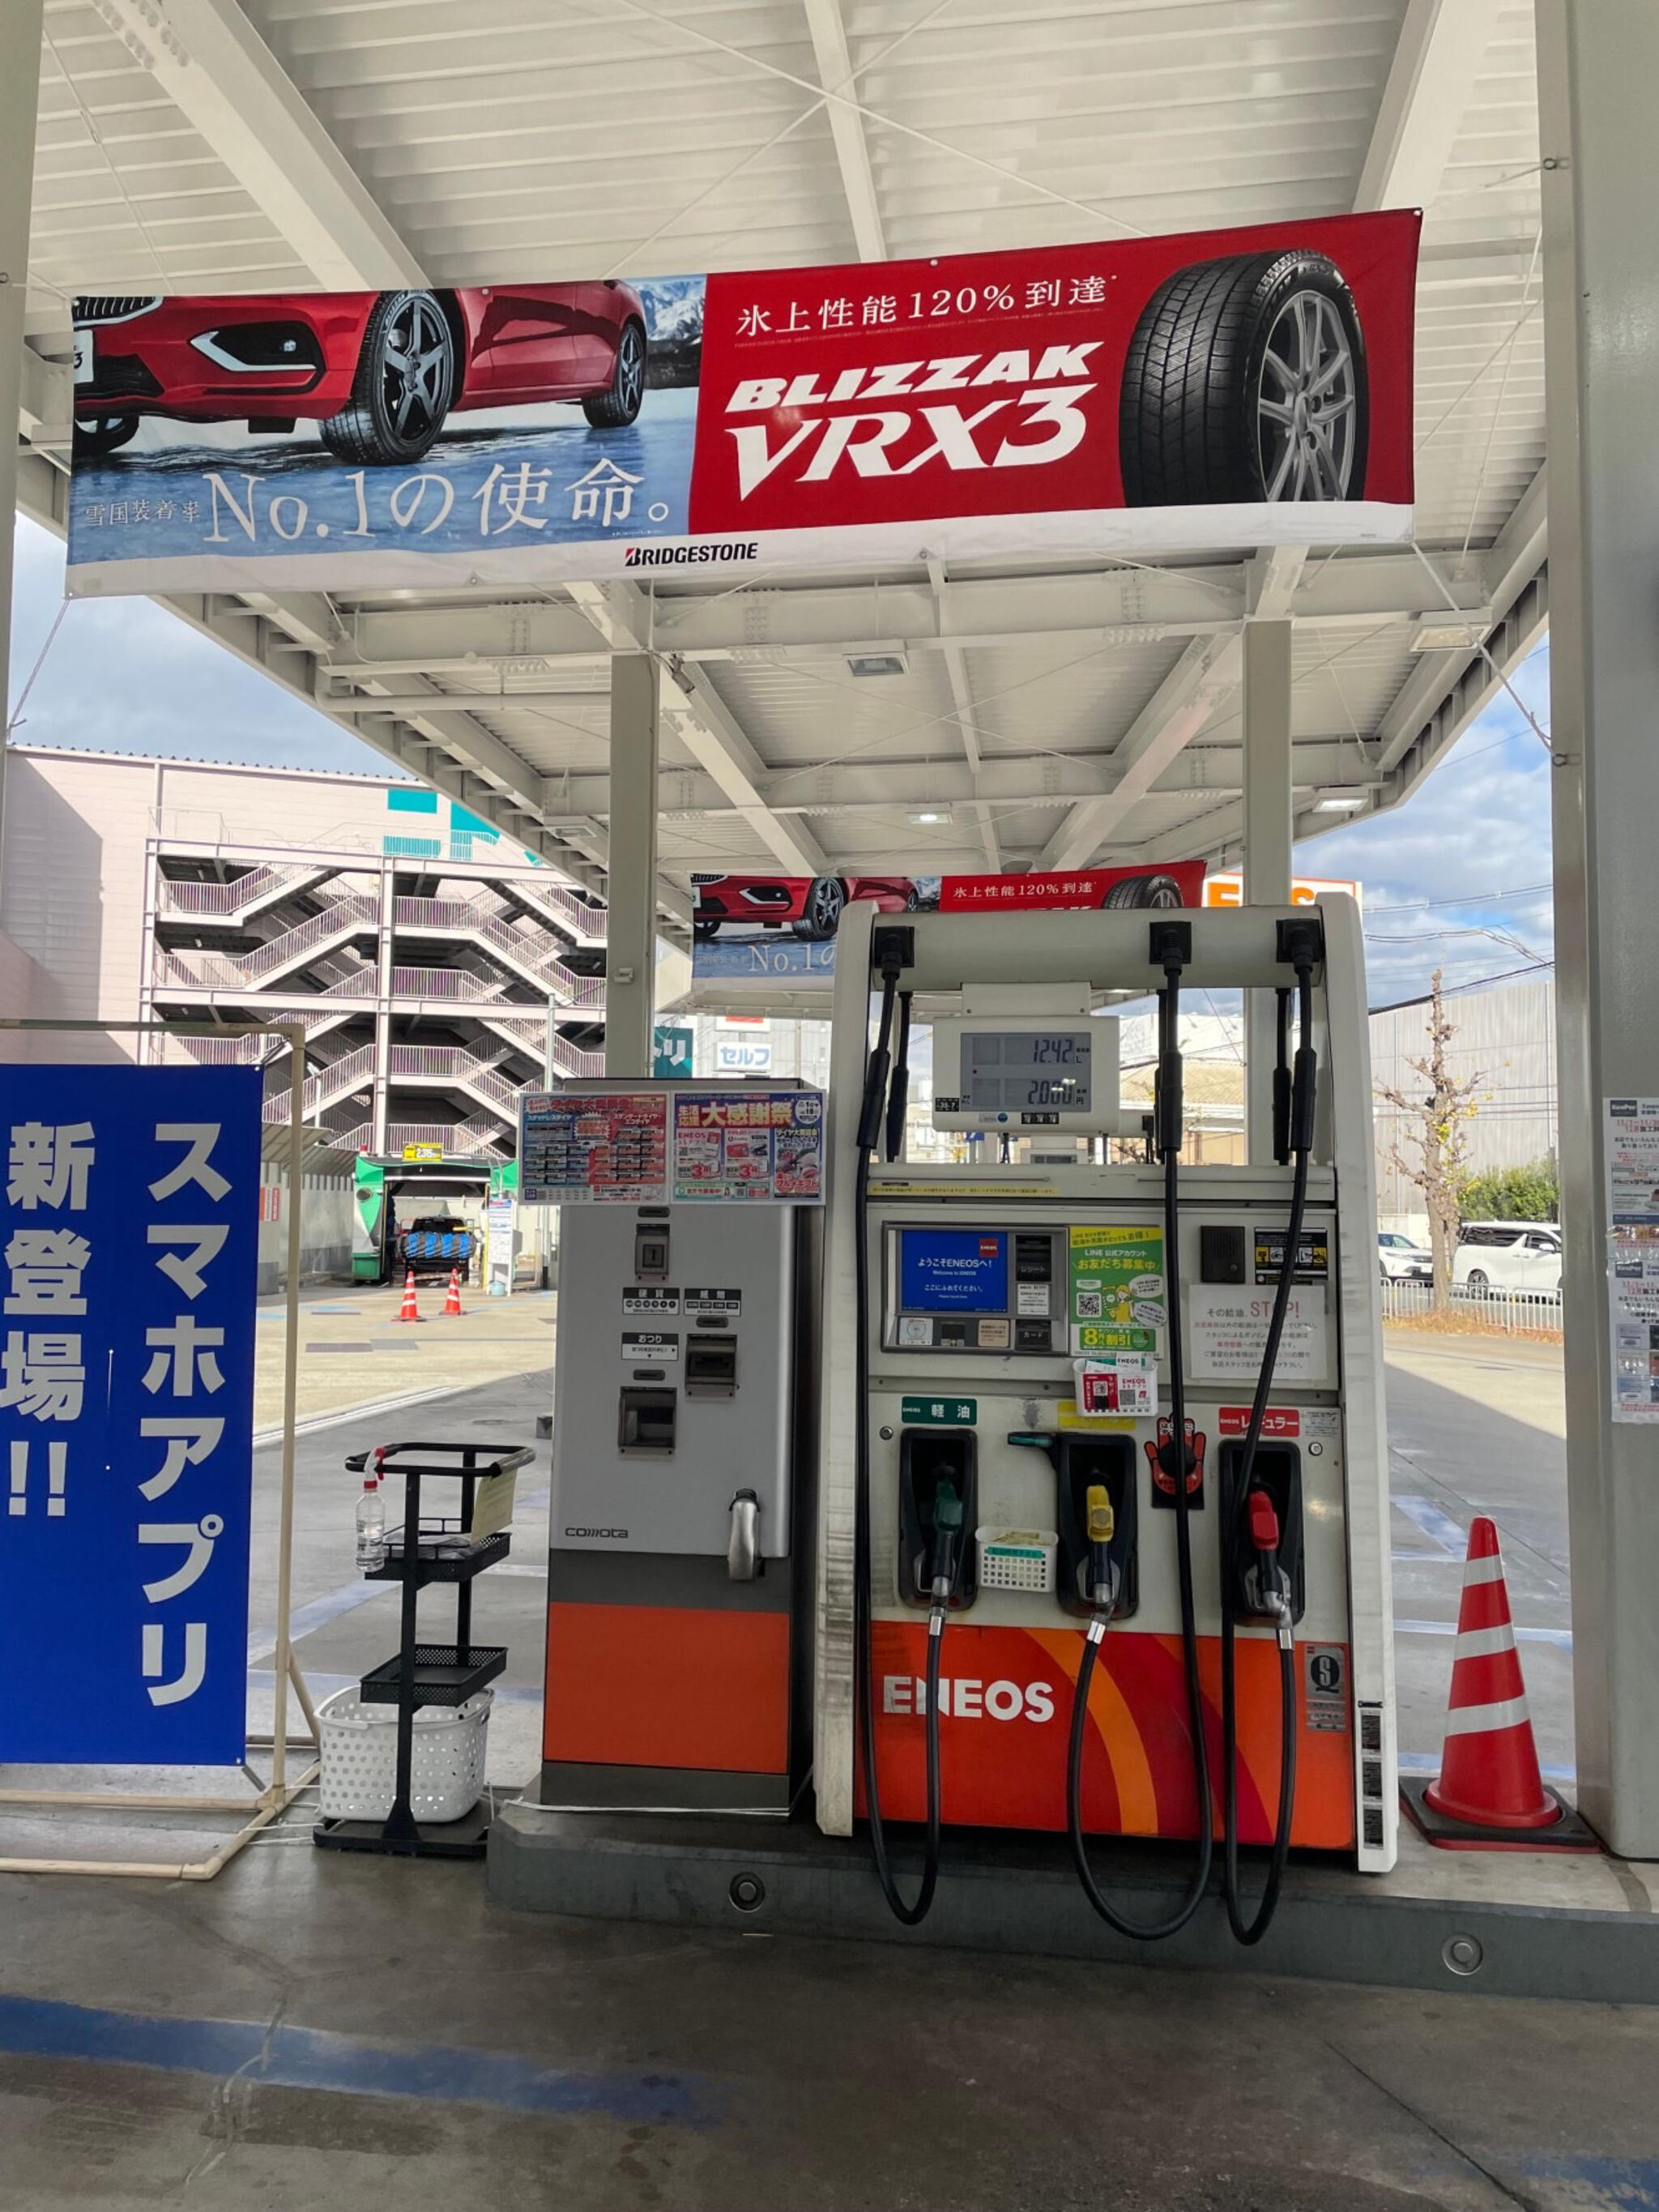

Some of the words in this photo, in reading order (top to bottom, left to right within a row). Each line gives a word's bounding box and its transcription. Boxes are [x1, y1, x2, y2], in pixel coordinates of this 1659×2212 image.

[725, 340, 1105, 413] BLIZZAK
[724, 383, 1098, 502] VRX3
[84, 498, 201, 527] 雪国装着率
[203, 457, 670, 544] No.1の使命。
[625, 542, 759, 567] BRIDGESTONE
[720, 1044, 770, 1066] セルフ
[1034, 1039, 1073, 1063] 12.42
[702, 1101, 792, 1127] 大感謝祭
[1077, 1258, 1157, 1270] お友だち募集中
[1084, 1249, 1103, 1257] LINE
[1104, 1249, 1148, 1258] 公式アカウント
[1250, 1300, 1300, 1319] STP!
[638, 1334, 663, 1344] おつり
[138, 1123, 232, 1706] スマホアプリ
[932, 1403, 970, 1419] 軽油
[1241, 1414, 1299, 1430] レュラー
[882, 1676, 1055, 1723] ENEOS
